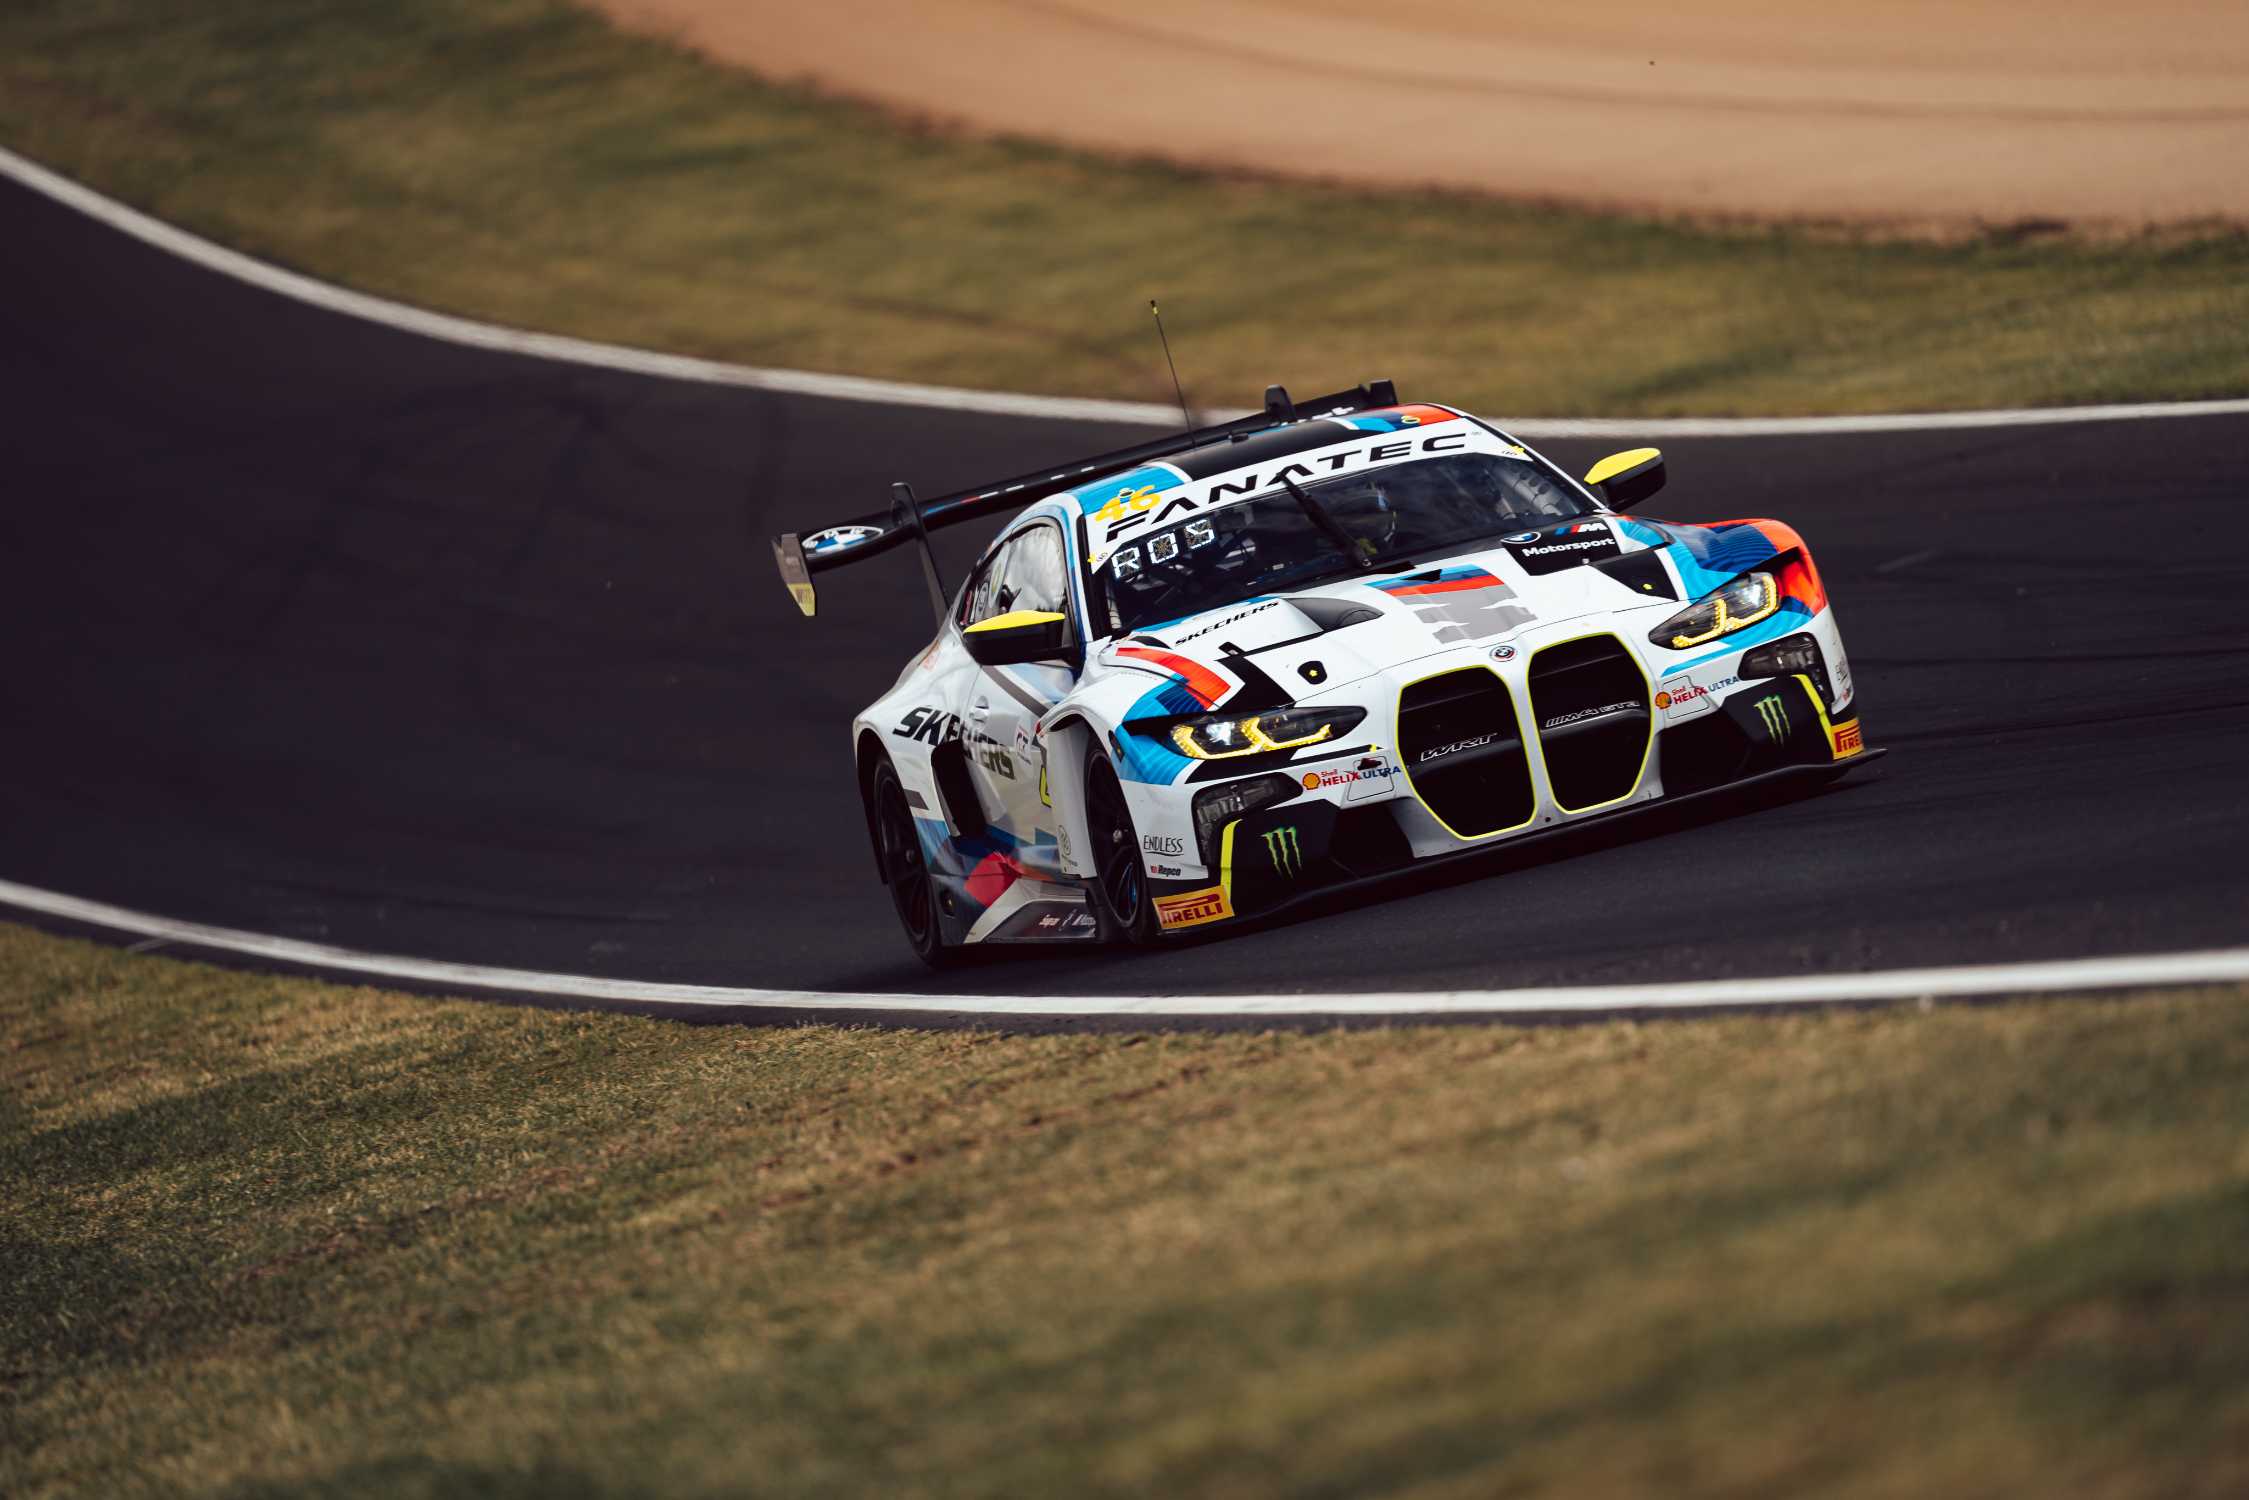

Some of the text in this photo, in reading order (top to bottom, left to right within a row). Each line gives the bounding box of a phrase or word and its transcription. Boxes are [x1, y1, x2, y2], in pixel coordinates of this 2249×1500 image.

[1095, 484, 1161, 522] 46
[1106, 433, 1466, 543] FANATEC
[1111, 518, 1215, 579] ROS
[1522, 537, 1616, 557] Motorsport
[1175, 601, 1279, 645] SKECHERS
[1673, 675, 1739, 704] HELIX ULTRA
[1420, 731, 1499, 762] WRT
[1322, 765, 1401, 786] HELIX ULTRA
[1143, 834, 1183, 854] ENDLESS
[1157, 865, 1182, 877] Repco
[1157, 893, 1224, 925] PIRELLI
